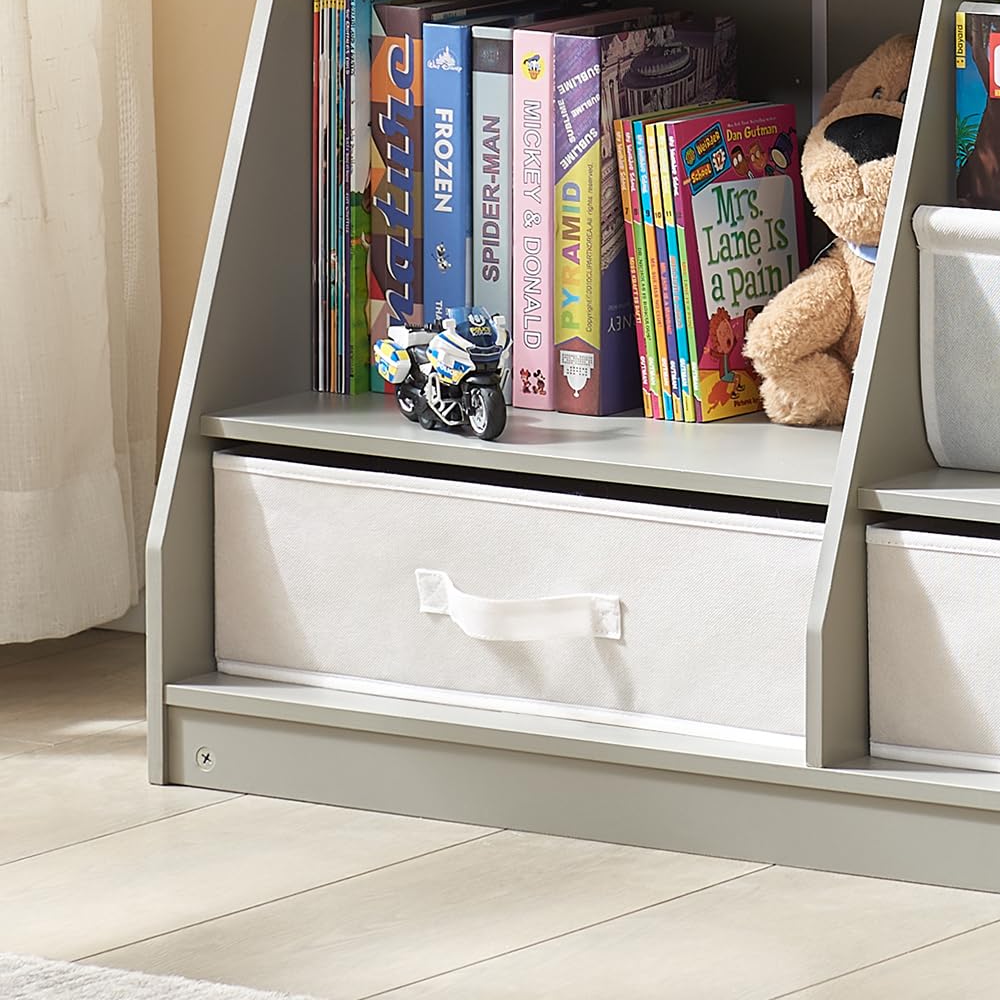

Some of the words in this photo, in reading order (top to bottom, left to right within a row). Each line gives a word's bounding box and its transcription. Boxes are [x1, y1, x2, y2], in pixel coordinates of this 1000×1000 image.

[522, 99, 542, 205] MICKEY
[559, 127, 598, 170] SUBLIME
[726, 128, 743, 143] Dan
[744, 124, 779, 139] Gutman
[433, 108, 454, 213] FROZEN
[714, 151, 724, 168] 12
[482, 115, 501, 283] SPIDER-MAN
[522, 209, 542, 229] &
[712, 185, 764, 228] Mrs.
[561, 181, 581, 330] PYRAMID
[702, 225, 761, 266] Lane
[522, 236, 542, 350] DONALD
[711, 272, 725, 302] a
[727, 254, 794, 307] pain!
